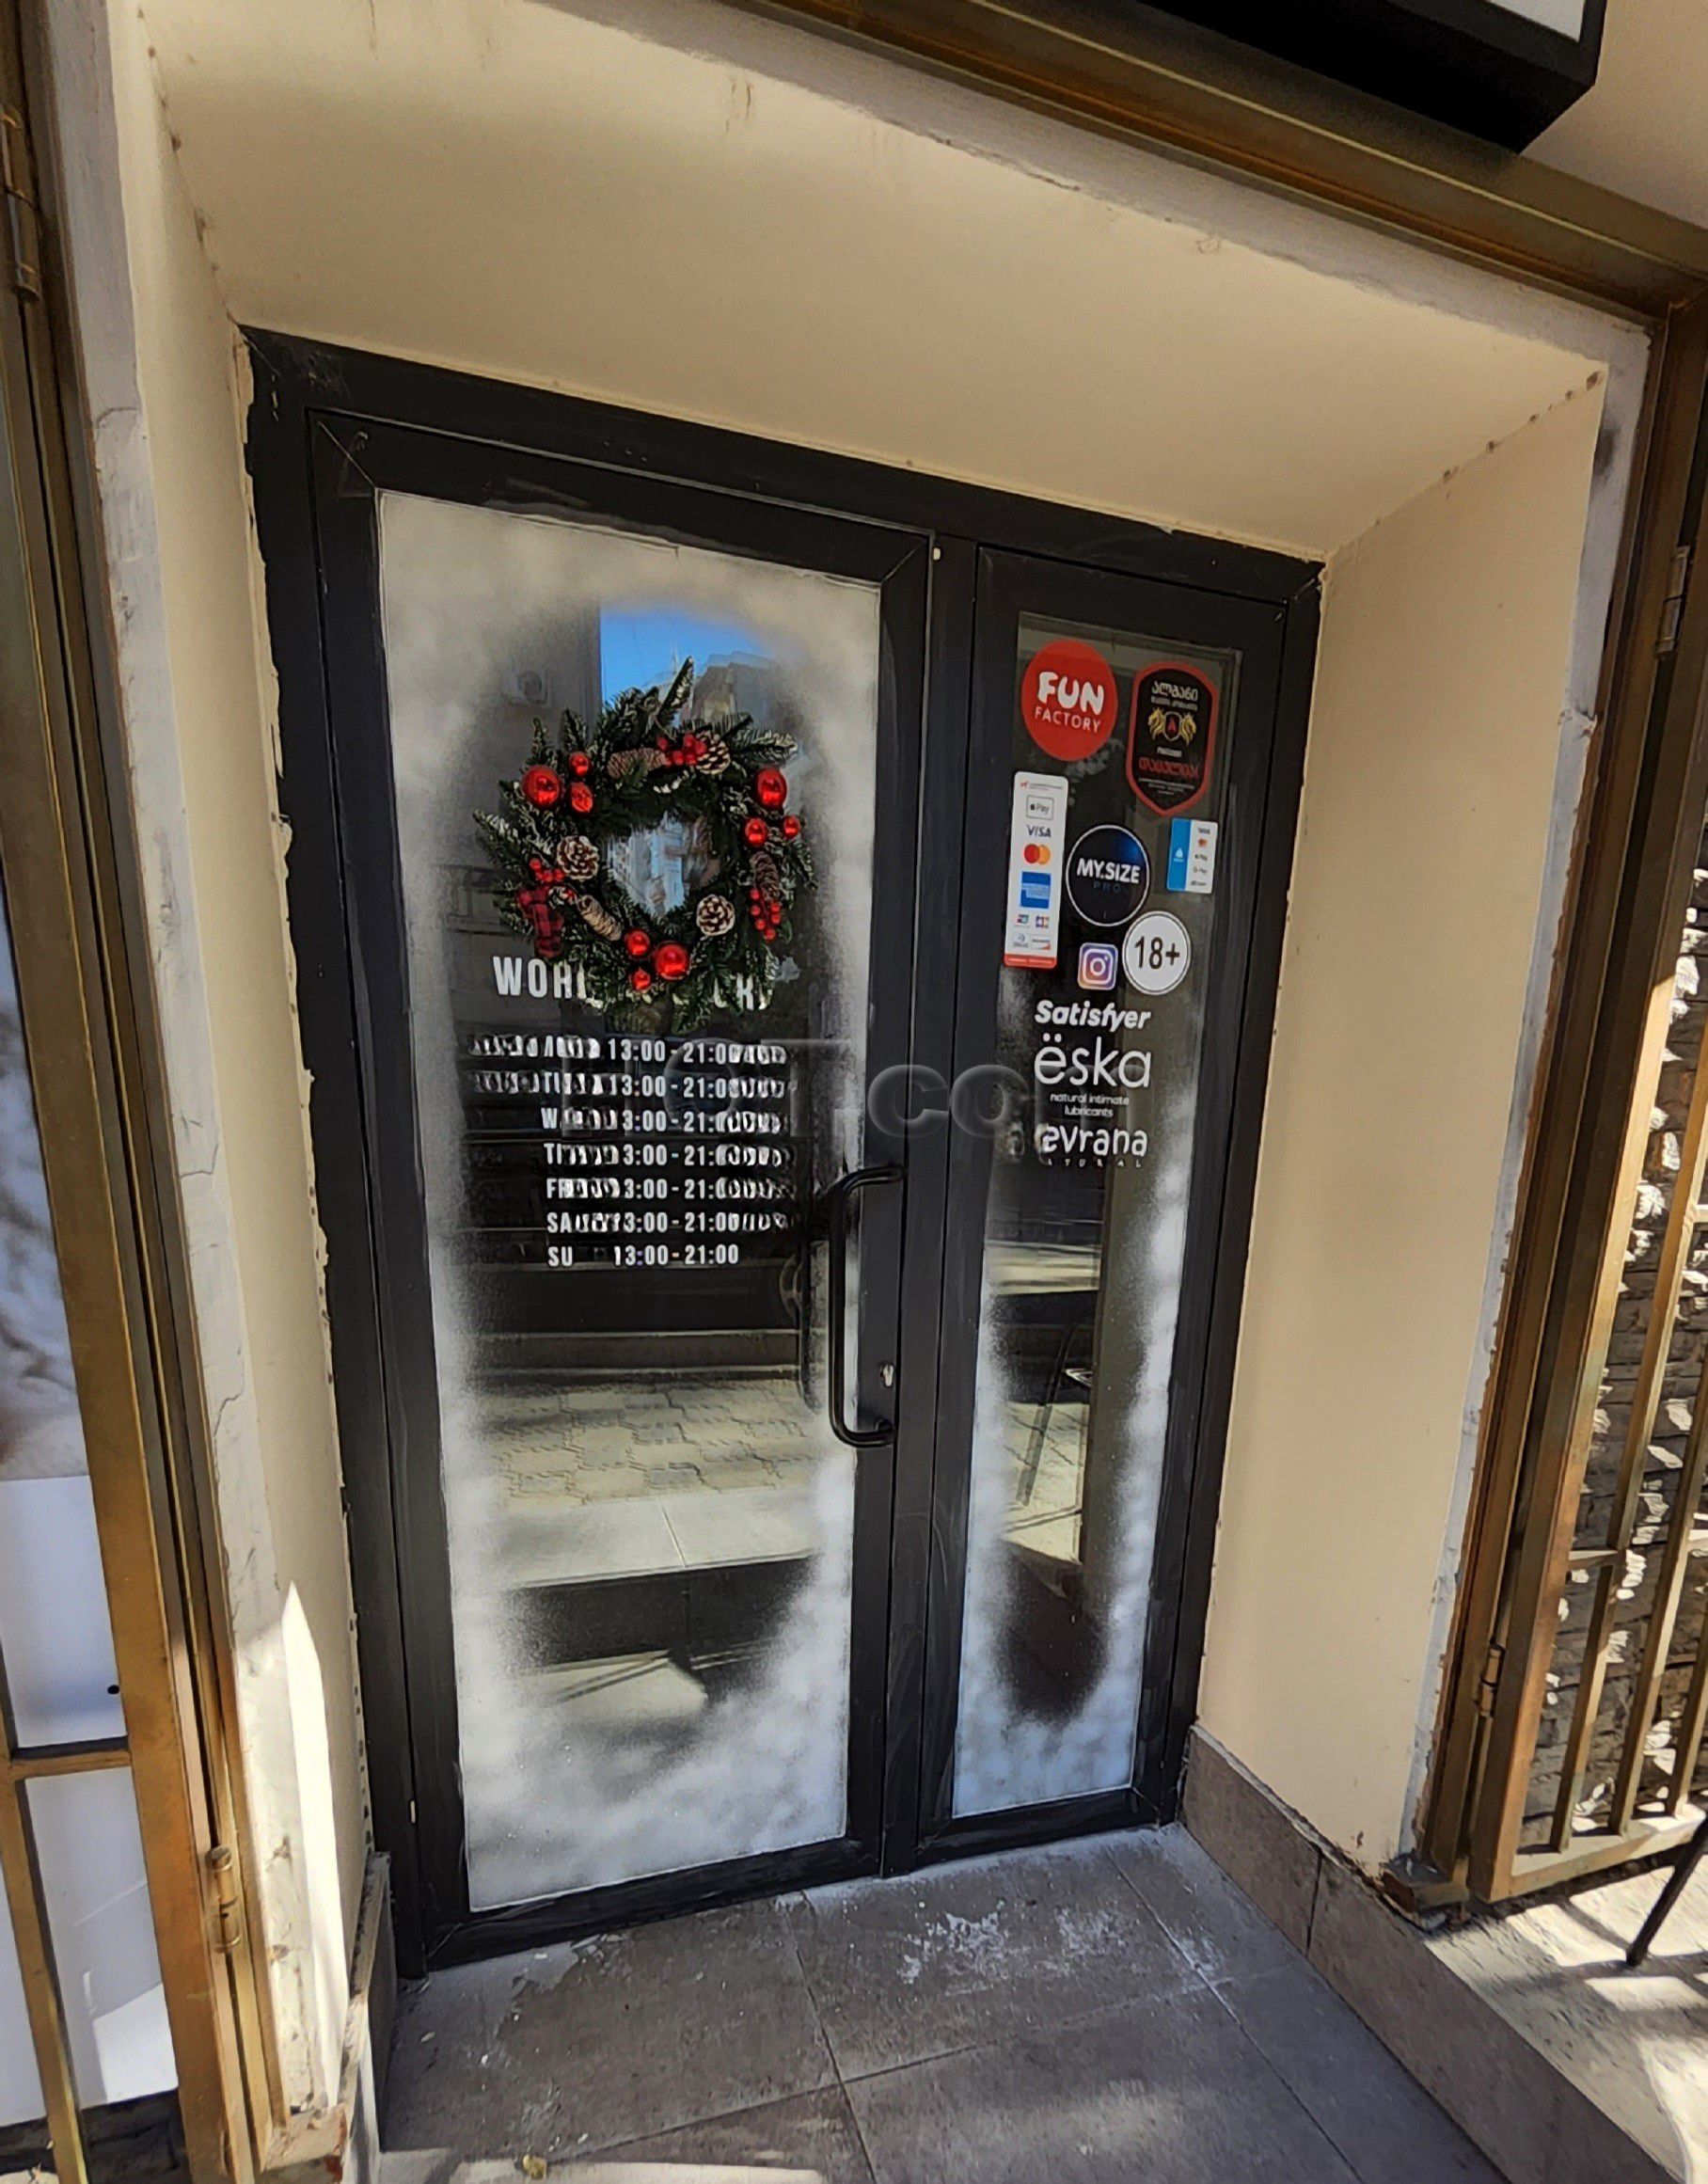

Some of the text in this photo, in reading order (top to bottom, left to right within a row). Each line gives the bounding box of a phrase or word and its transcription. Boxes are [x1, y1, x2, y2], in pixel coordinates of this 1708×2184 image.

[1037, 671, 1104, 715] FUN
[1035, 705, 1101, 734] FACTORY
[1026, 824, 1052, 839] VISA
[1076, 858, 1141, 885] MY.SIZE
[1134, 935, 1180, 970] 18+
[1035, 999, 1151, 1032] Satisfyer
[608, 1037, 666, 1063] 13:00
[1035, 1033, 1151, 1088] ëska
[609, 1073, 667, 1098] 13:00
[1050, 1093, 1130, 1106] natural intimate
[1064, 1104, 1115, 1118] lubricants
[684, 1211, 741, 1233] 21:00
[613, 1244, 669, 1266] 13:00
[684, 1243, 739, 1265] 21:00
